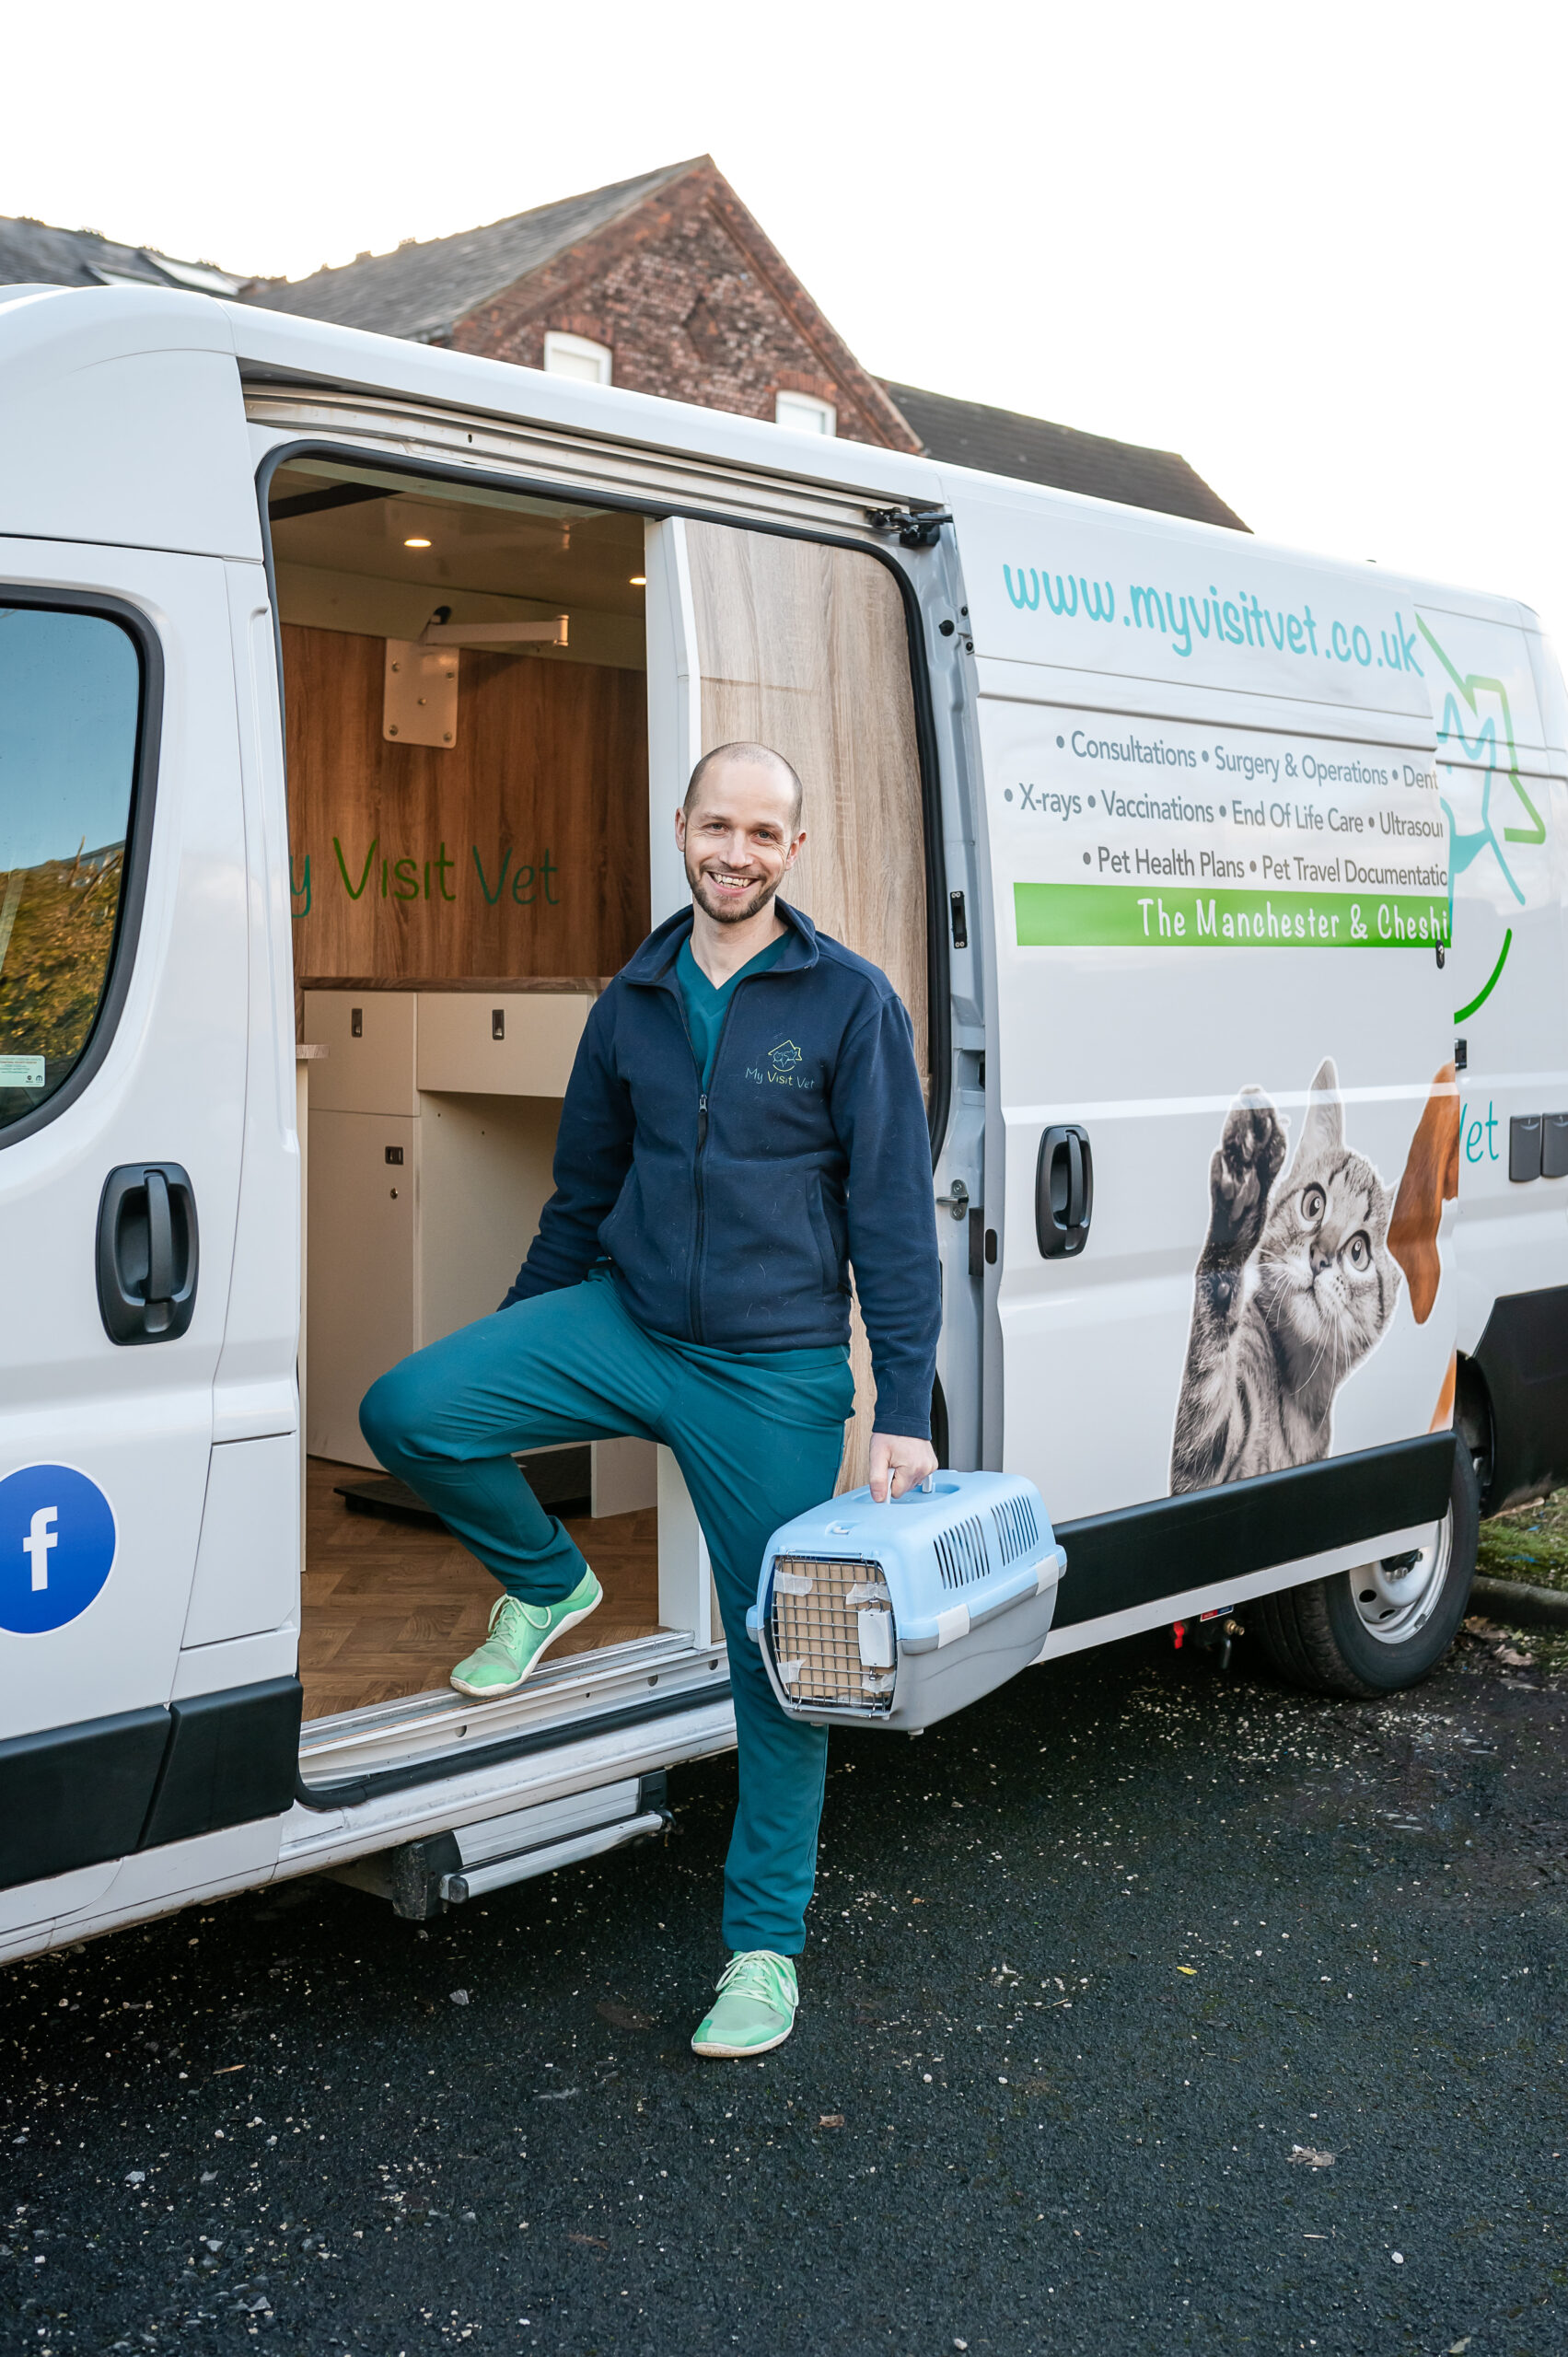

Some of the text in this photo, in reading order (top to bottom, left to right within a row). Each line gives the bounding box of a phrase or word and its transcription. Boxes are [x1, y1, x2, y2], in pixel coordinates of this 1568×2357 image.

[1003, 563, 1424, 678] www.myvisitvet.co.uk
[1071, 730, 1197, 768] Consultations
[1214, 745, 1280, 783] Surgery
[1284, 752, 1298, 778] &
[1302, 754, 1388, 786] Operations
[1018, 783, 1444, 838] X-rays Vaccinations End Of Life Care Ultrasou
[332, 836, 456, 901] Visit
[472, 845, 560, 905] Vet
[1098, 846, 1131, 874] Pet
[1135, 848, 1195, 876] Health
[1200, 850, 1245, 878] Plans
[1262, 854, 1290, 881] Pet
[1294, 856, 1341, 883] Travel
[1137, 898, 1186, 937] The
[1196, 899, 1340, 939] Manchester
[1350, 903, 1368, 940] &
[745, 1067, 815, 1088] My Visit Vet
[23, 1505, 58, 1592] f
